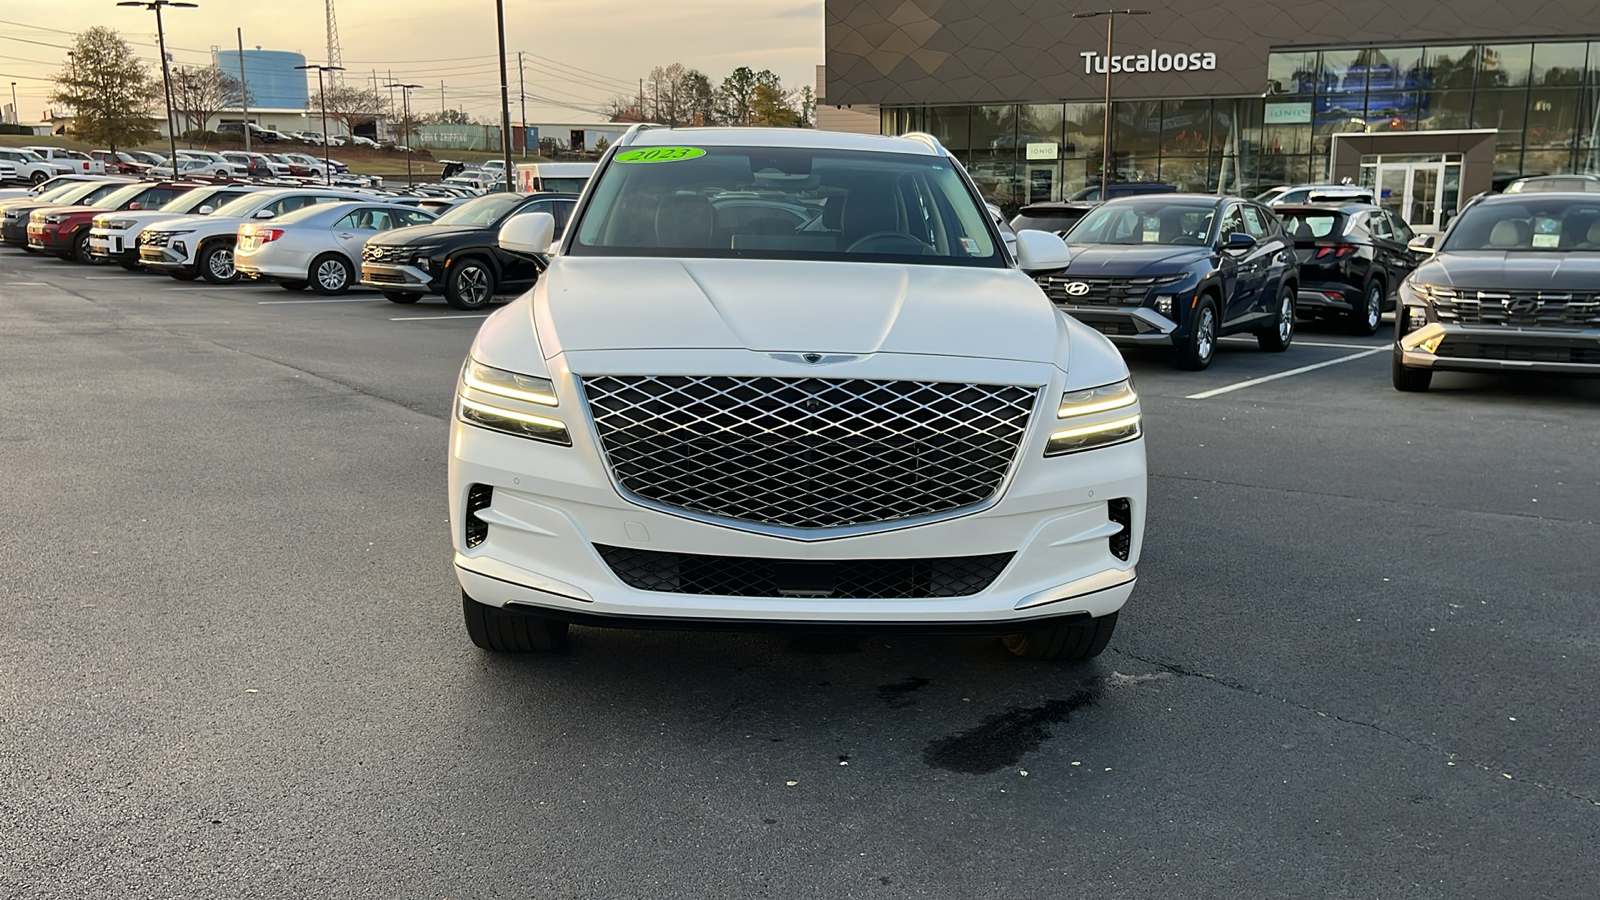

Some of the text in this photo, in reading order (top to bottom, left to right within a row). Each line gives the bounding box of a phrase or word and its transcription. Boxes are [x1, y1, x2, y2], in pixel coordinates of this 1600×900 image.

[1080, 48, 1216, 74] Tuscaloosa
[440, 132, 468, 142] SHIPPING
[627, 148, 691, 161] 2023
